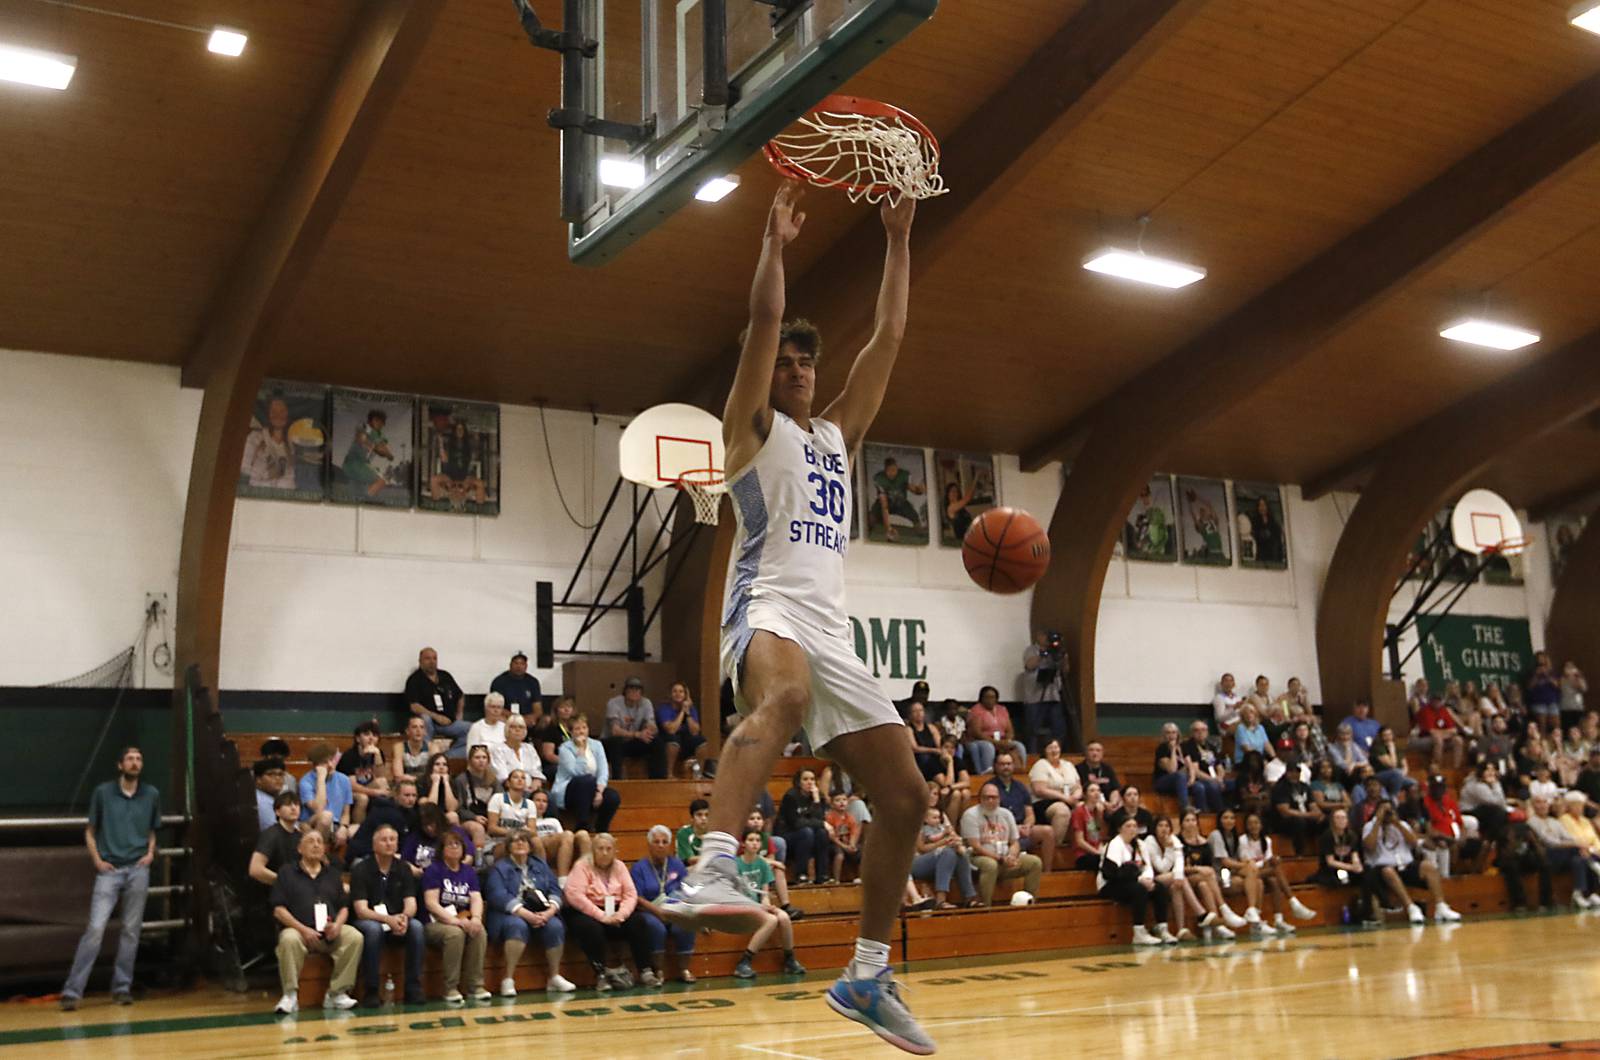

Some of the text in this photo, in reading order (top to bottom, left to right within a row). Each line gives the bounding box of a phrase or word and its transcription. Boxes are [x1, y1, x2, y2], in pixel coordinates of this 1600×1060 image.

[804, 444, 845, 474] BUE
[808, 472, 845, 523] 30
[1472, 624, 1504, 645] THE
[1460, 648, 1521, 673] GIANTS
